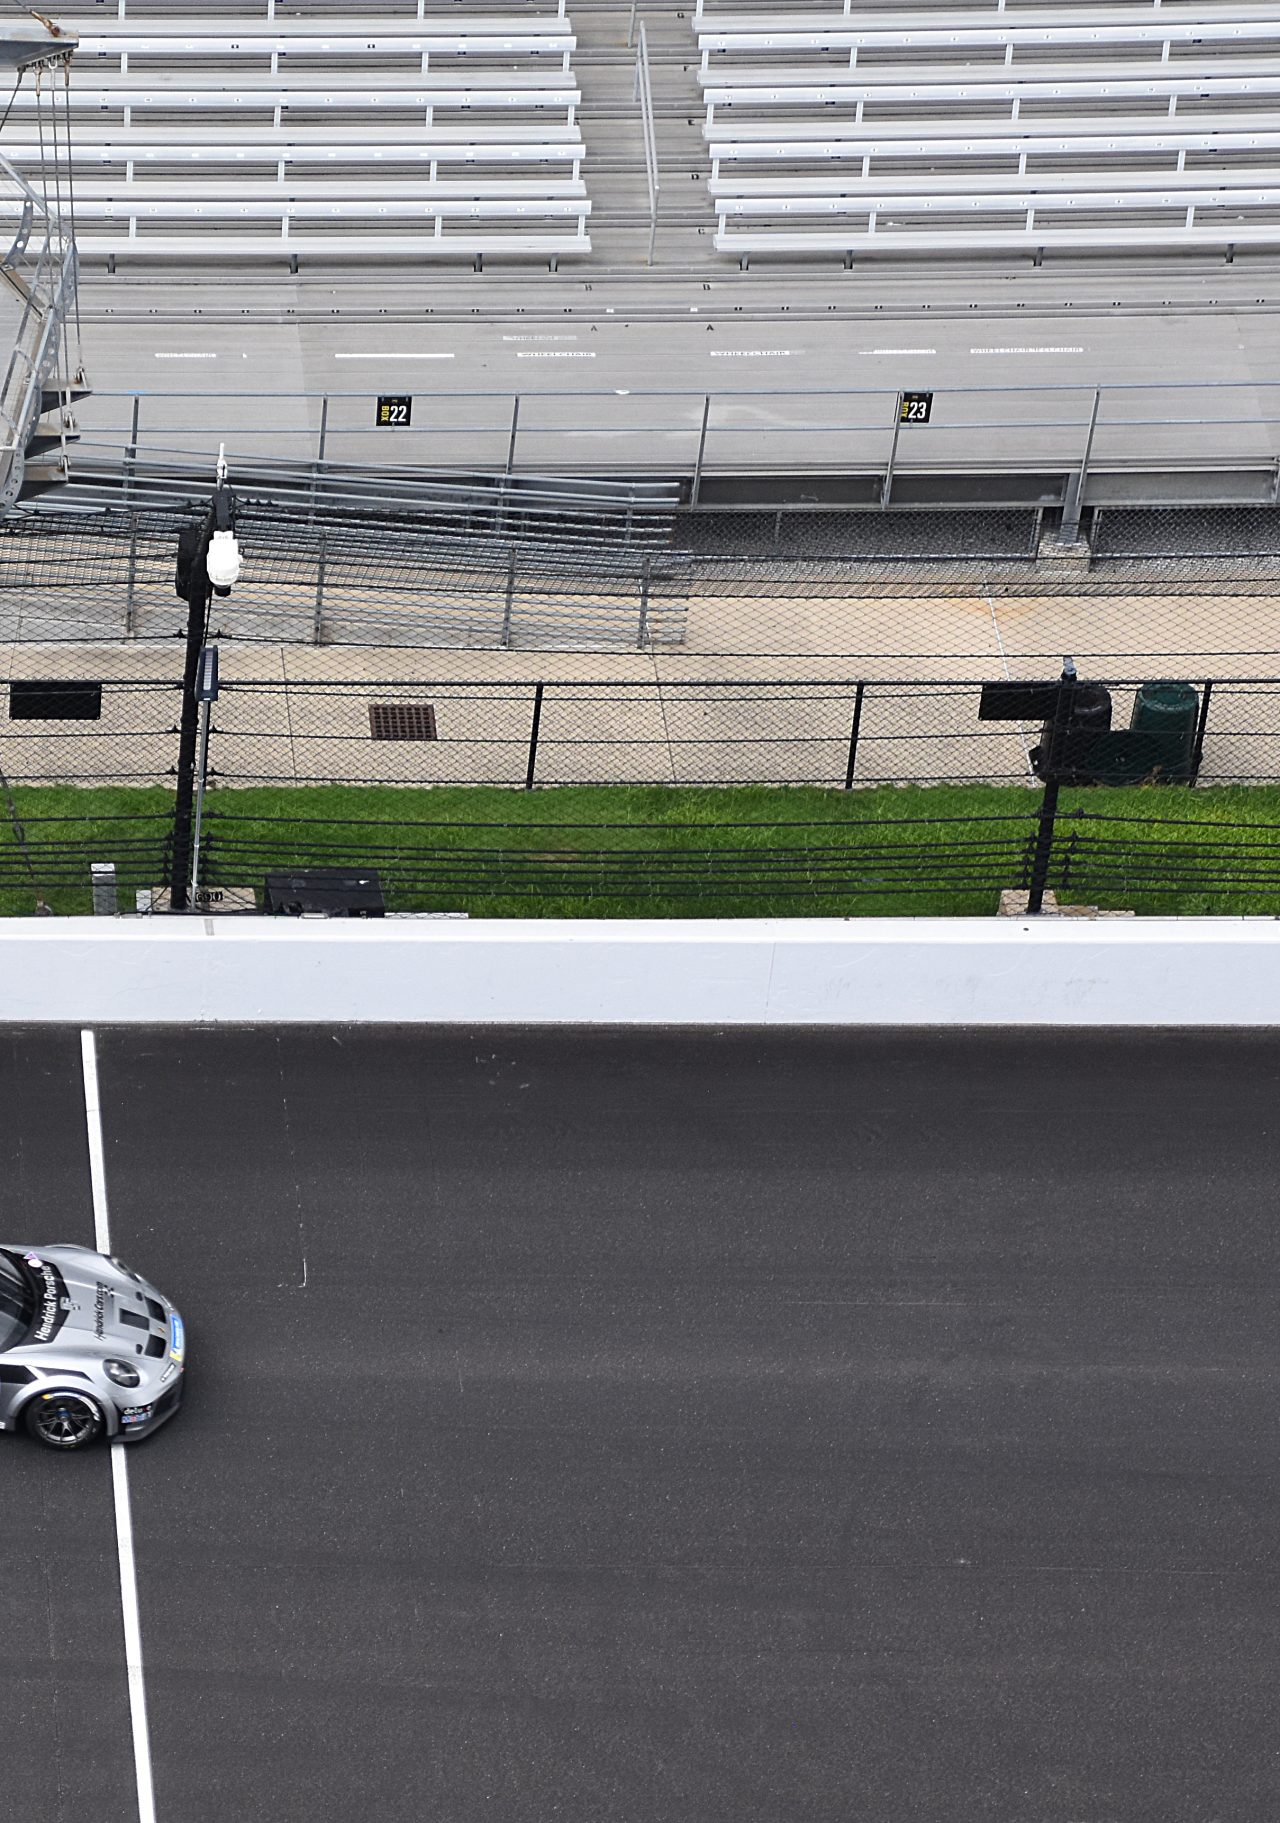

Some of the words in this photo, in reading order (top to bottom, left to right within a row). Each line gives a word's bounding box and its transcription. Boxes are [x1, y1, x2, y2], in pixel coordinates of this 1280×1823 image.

[380, 405, 390, 422] BOX
[390, 405, 407, 422] 22
[908, 402, 927, 419] 23
[41, 1265, 57, 1300] Porsche
[34, 1300, 56, 1341] Hendrick
